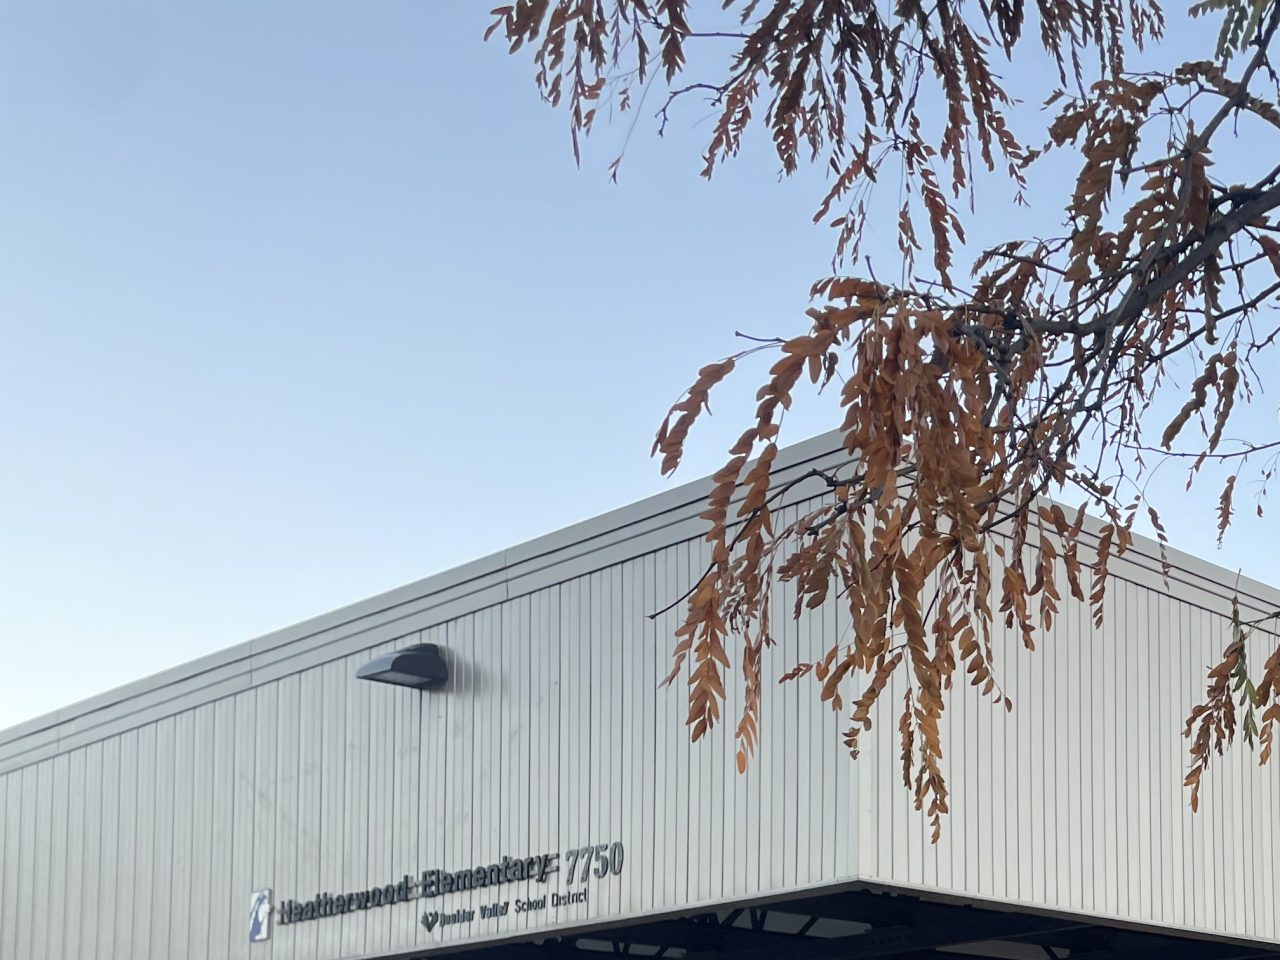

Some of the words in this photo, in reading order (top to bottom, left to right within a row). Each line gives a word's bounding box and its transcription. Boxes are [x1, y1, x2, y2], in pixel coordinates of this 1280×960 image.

[277, 874, 411, 925] Heatherwood
[422, 853, 551, 898] Elementary
[565, 842, 625, 885] 7750
[439, 909, 476, 927] Boulder
[480, 901, 510, 920] Valley
[514, 895, 546, 914] School
[551, 888, 588, 908] District
